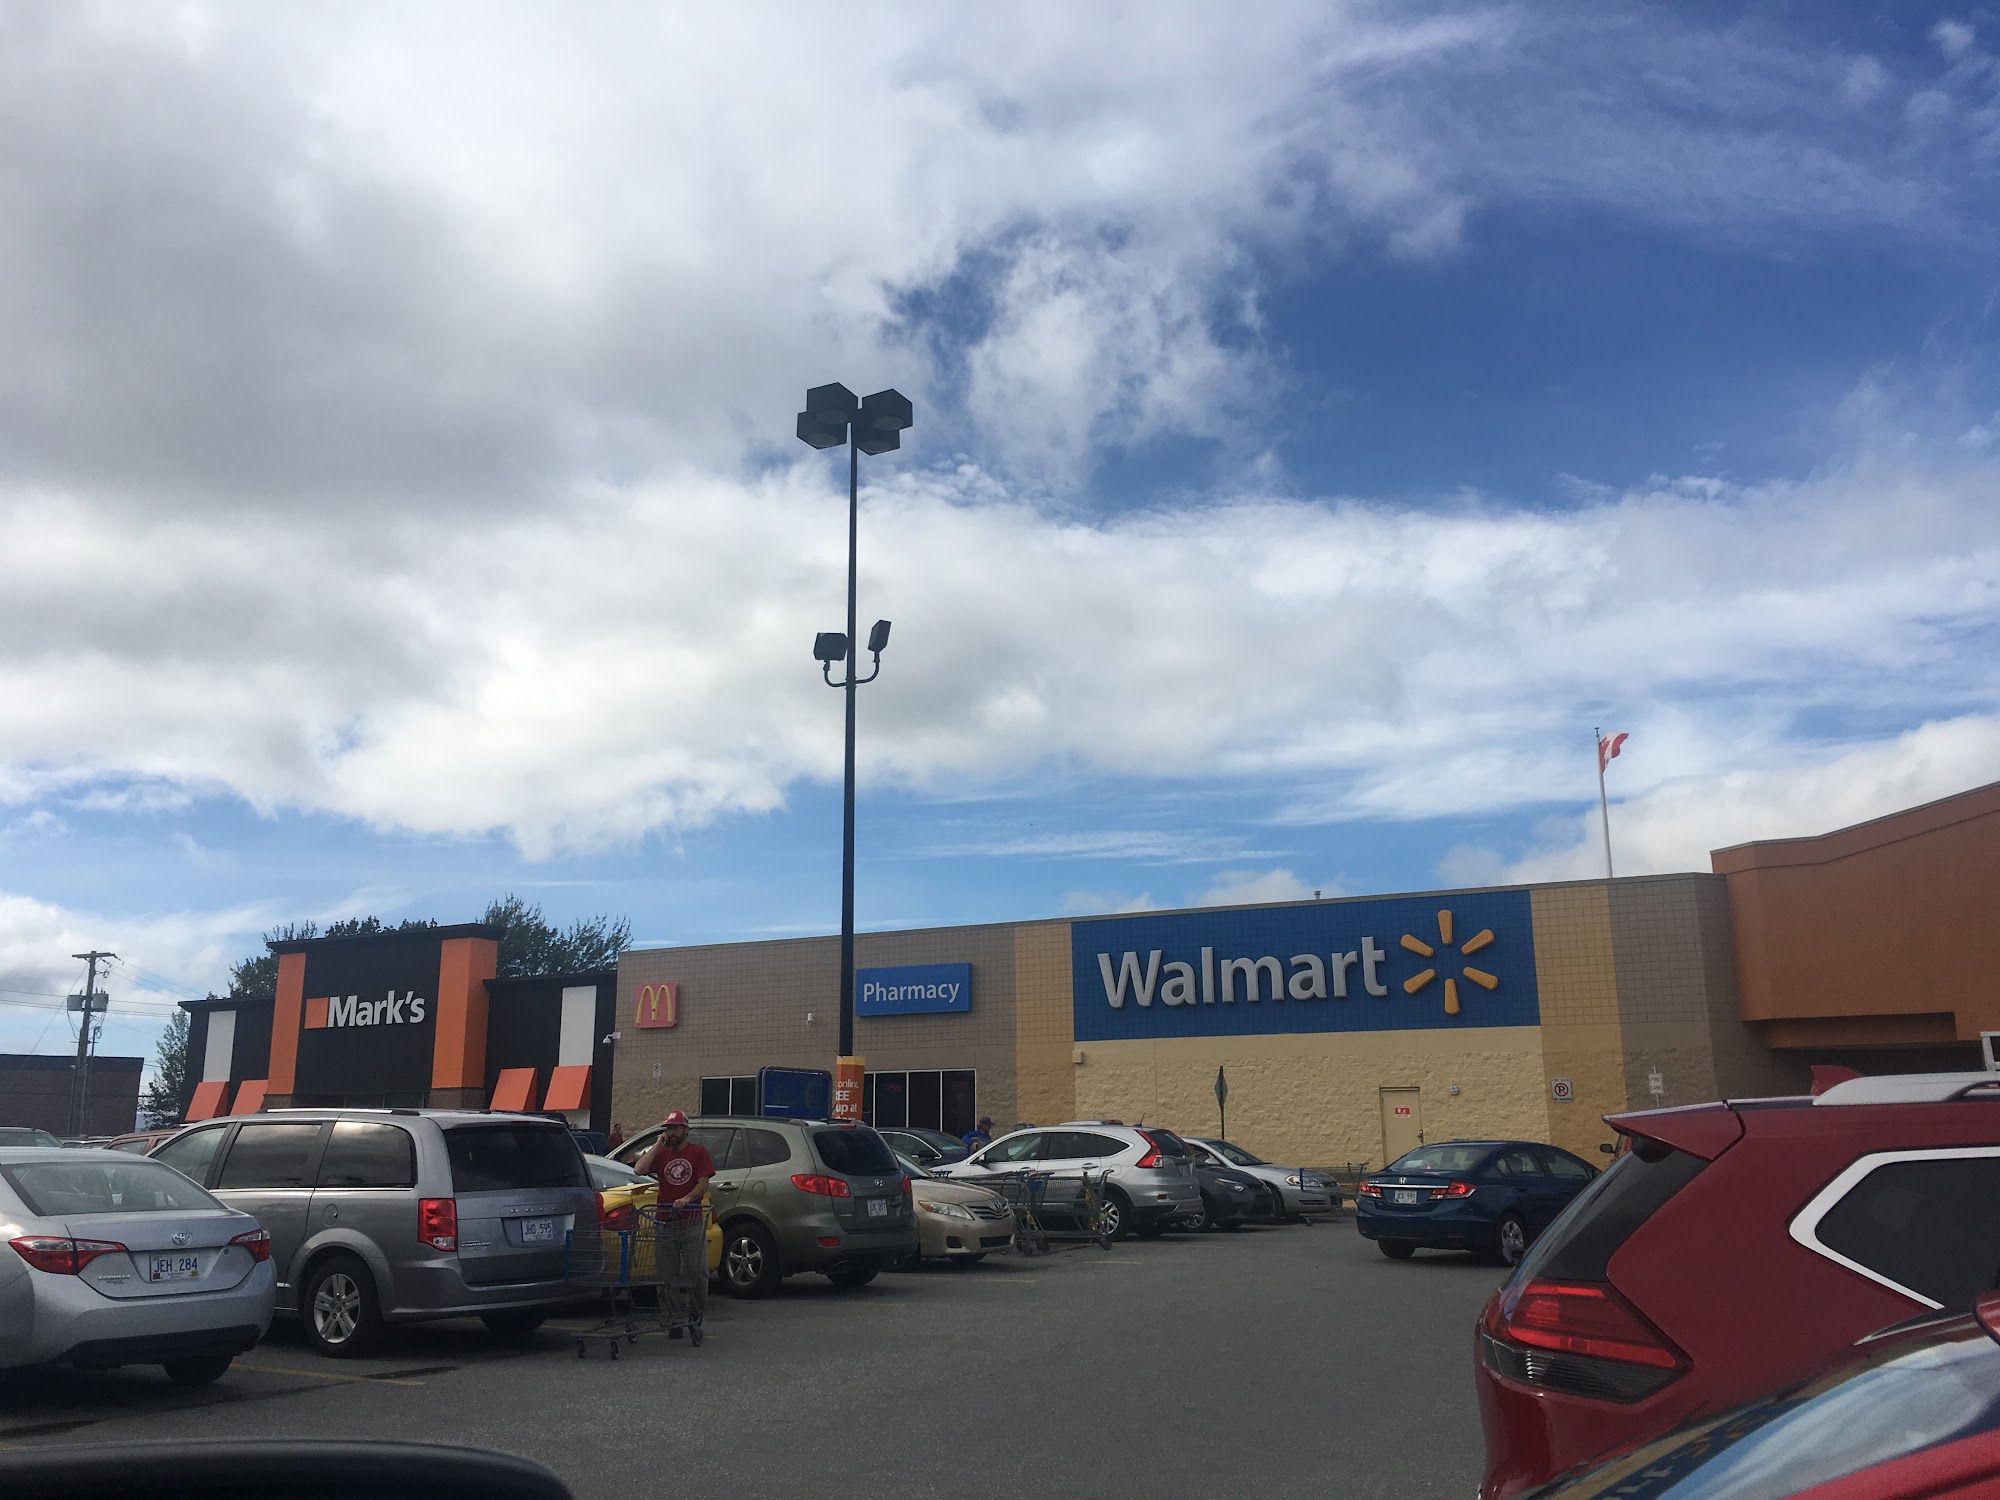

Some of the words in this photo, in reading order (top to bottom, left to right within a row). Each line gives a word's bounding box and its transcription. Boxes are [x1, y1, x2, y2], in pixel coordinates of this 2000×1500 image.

[1097, 936, 1388, 1009] Walmart
[863, 981, 960, 1004] Pharmacy
[327, 990, 425, 1028] Mark's
[836, 1103, 848, 1114] up
[850, 1103, 857, 1113] at
[539, 1222, 552, 1234] 595
[154, 1259, 172, 1273] JEH
[179, 1257, 198, 1271] 284
